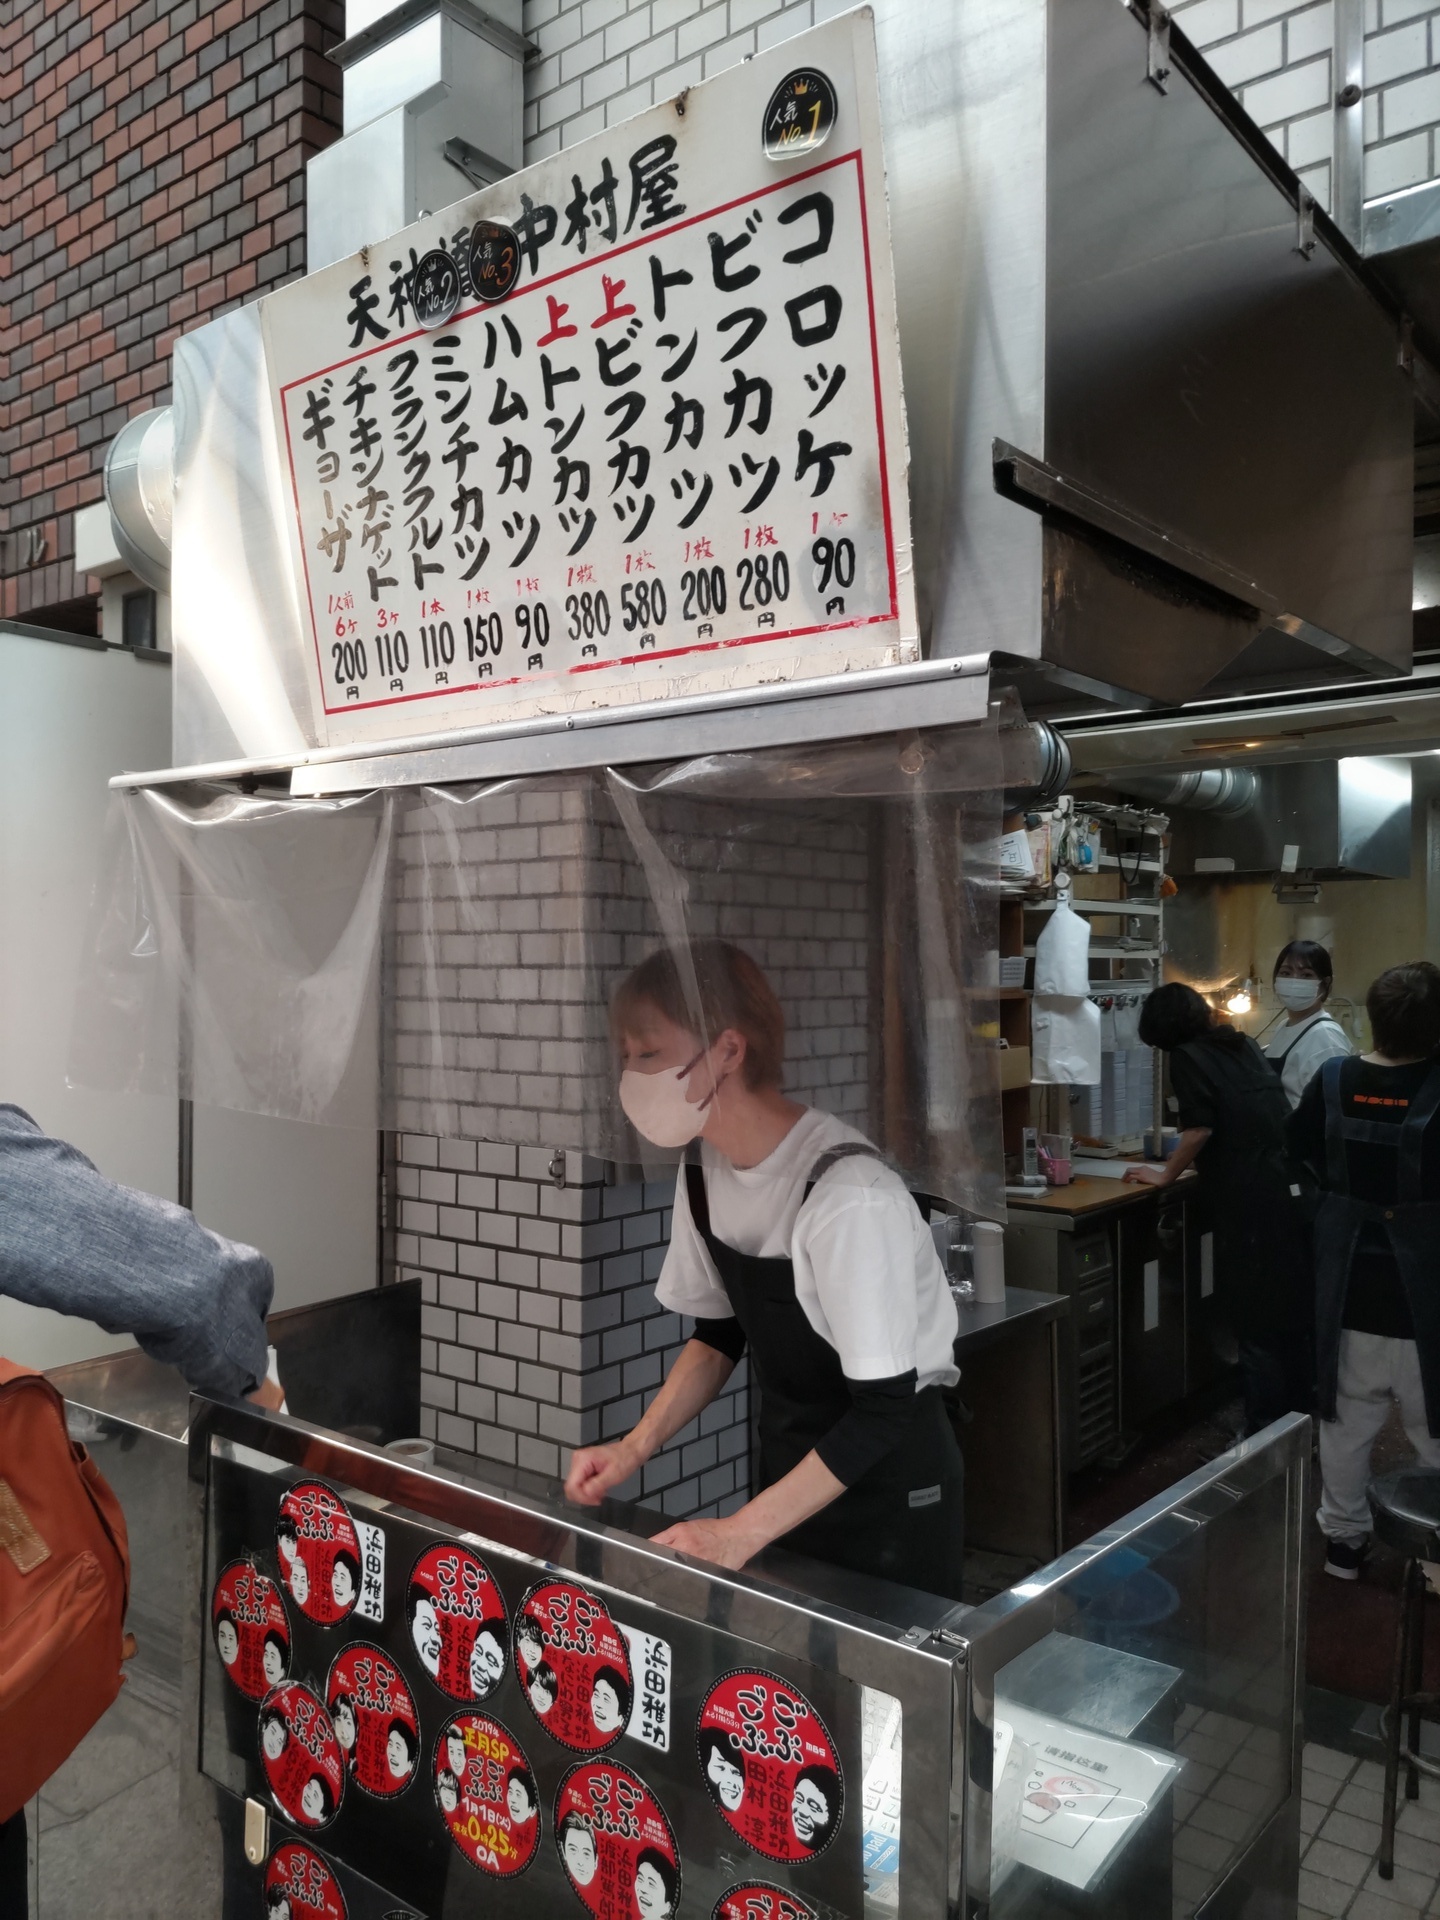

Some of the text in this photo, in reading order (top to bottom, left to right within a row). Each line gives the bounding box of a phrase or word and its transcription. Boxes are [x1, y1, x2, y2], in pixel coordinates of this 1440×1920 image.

[769, 101, 798, 131] 人気
[417, 277, 434, 304] 人気
[472, 241, 493, 262] 人気
[707, 209, 780, 514] ビフカツ
[777, 191, 852, 498] コロッケ
[342, 365, 399, 602] チキンナゲット
[386, 349, 444, 591] フランクフルト
[431, 335, 490, 581] ミンチカツ
[483, 313, 540, 568] ハムカツ
[536, 294, 597, 557] 上トンカツ
[590, 273, 655, 544] 上ビフカツ
[649, 254, 714, 530] トンカツ
[364, 1527, 383, 1619] 浜田雅功
[642, 1637, 669, 1748] 浜田雅功
[576, 1660, 592, 1744] 浜田雅功
[768, 1765, 790, 1856] 浜田雅功
